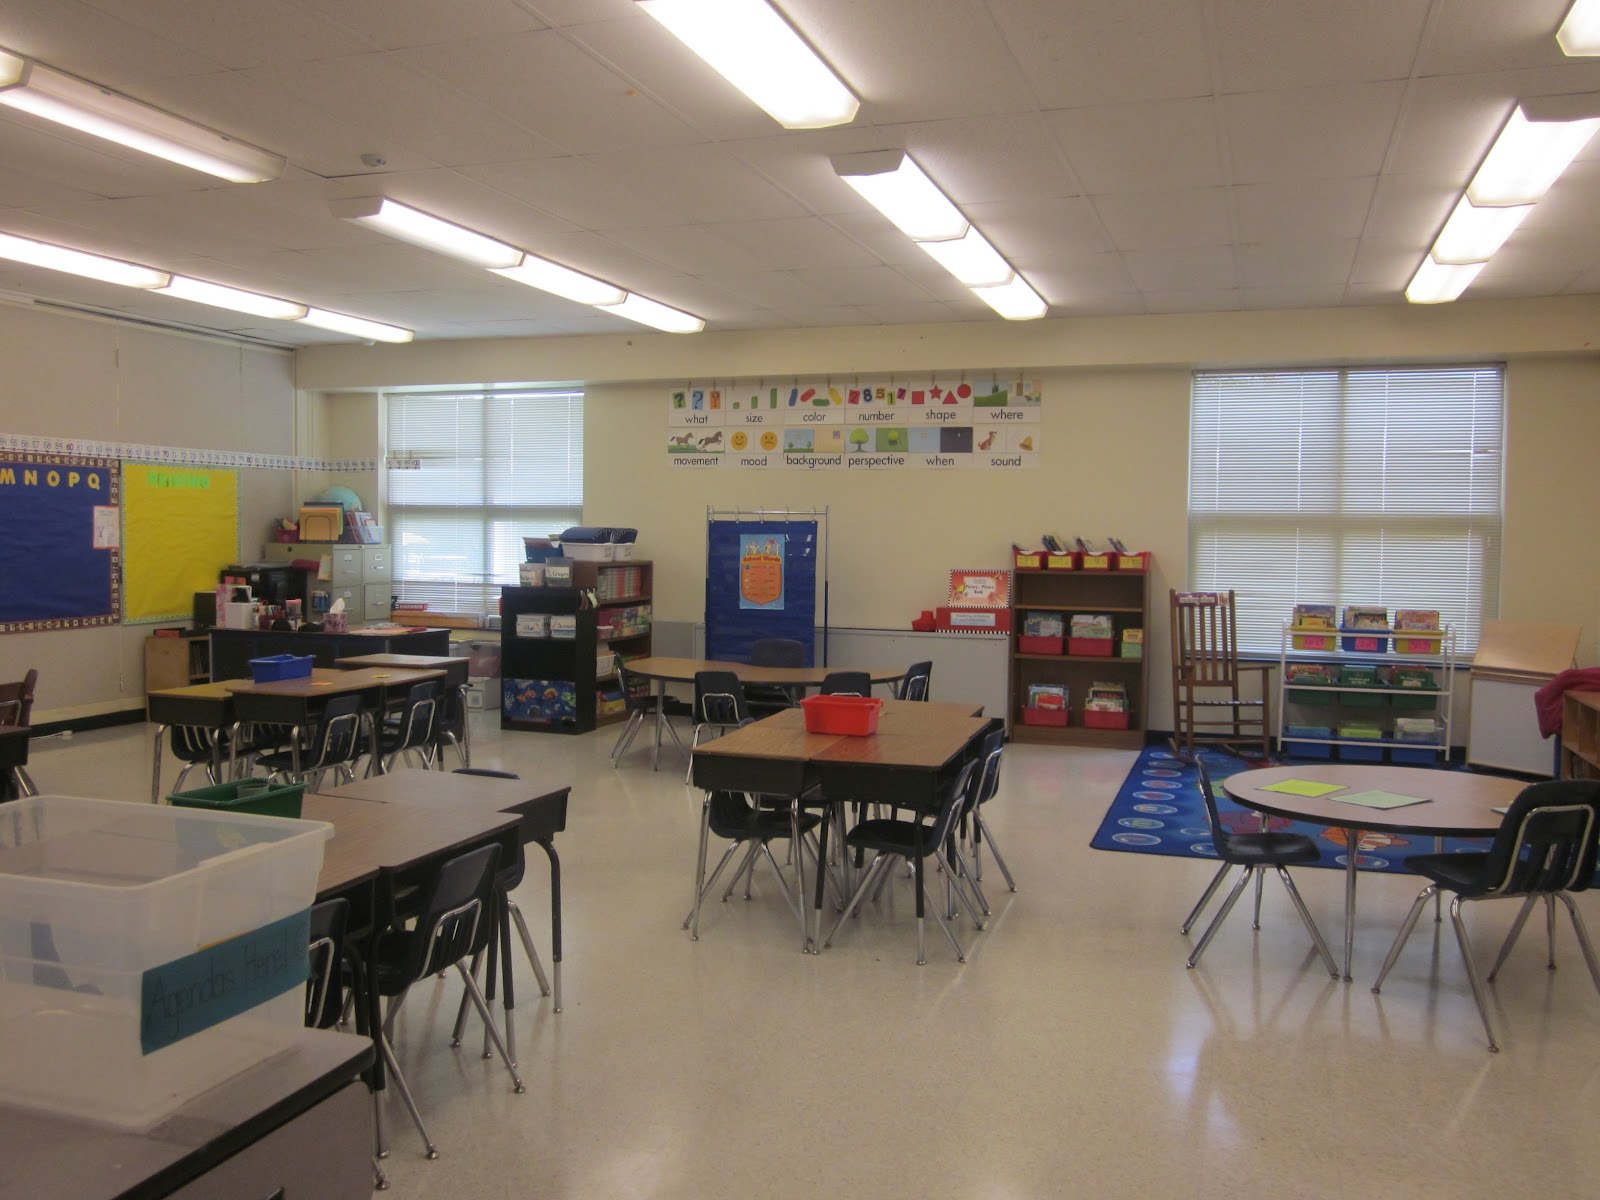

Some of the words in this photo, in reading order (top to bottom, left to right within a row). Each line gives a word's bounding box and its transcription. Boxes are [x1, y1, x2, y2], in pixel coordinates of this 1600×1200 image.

[685, 414, 709, 424] what
[745, 413, 763, 423] size
[802, 411, 826, 422] color
[858, 410, 895, 421] number
[925, 409, 957, 424] shape
[990, 409, 1024, 420] where
[673, 457, 719, 466] movement
[740, 456, 768, 466] mood
[786, 455, 842, 469] background
[848, 454, 905, 469] perspective
[925, 456, 955, 466] when
[990, 456, 1022, 466] sound
[0, 468, 16, 485] M
[24, 470, 38, 486] N
[47, 471, 60, 487] O
[69, 472, 80, 488] P
[87, 473, 100, 490] Q
